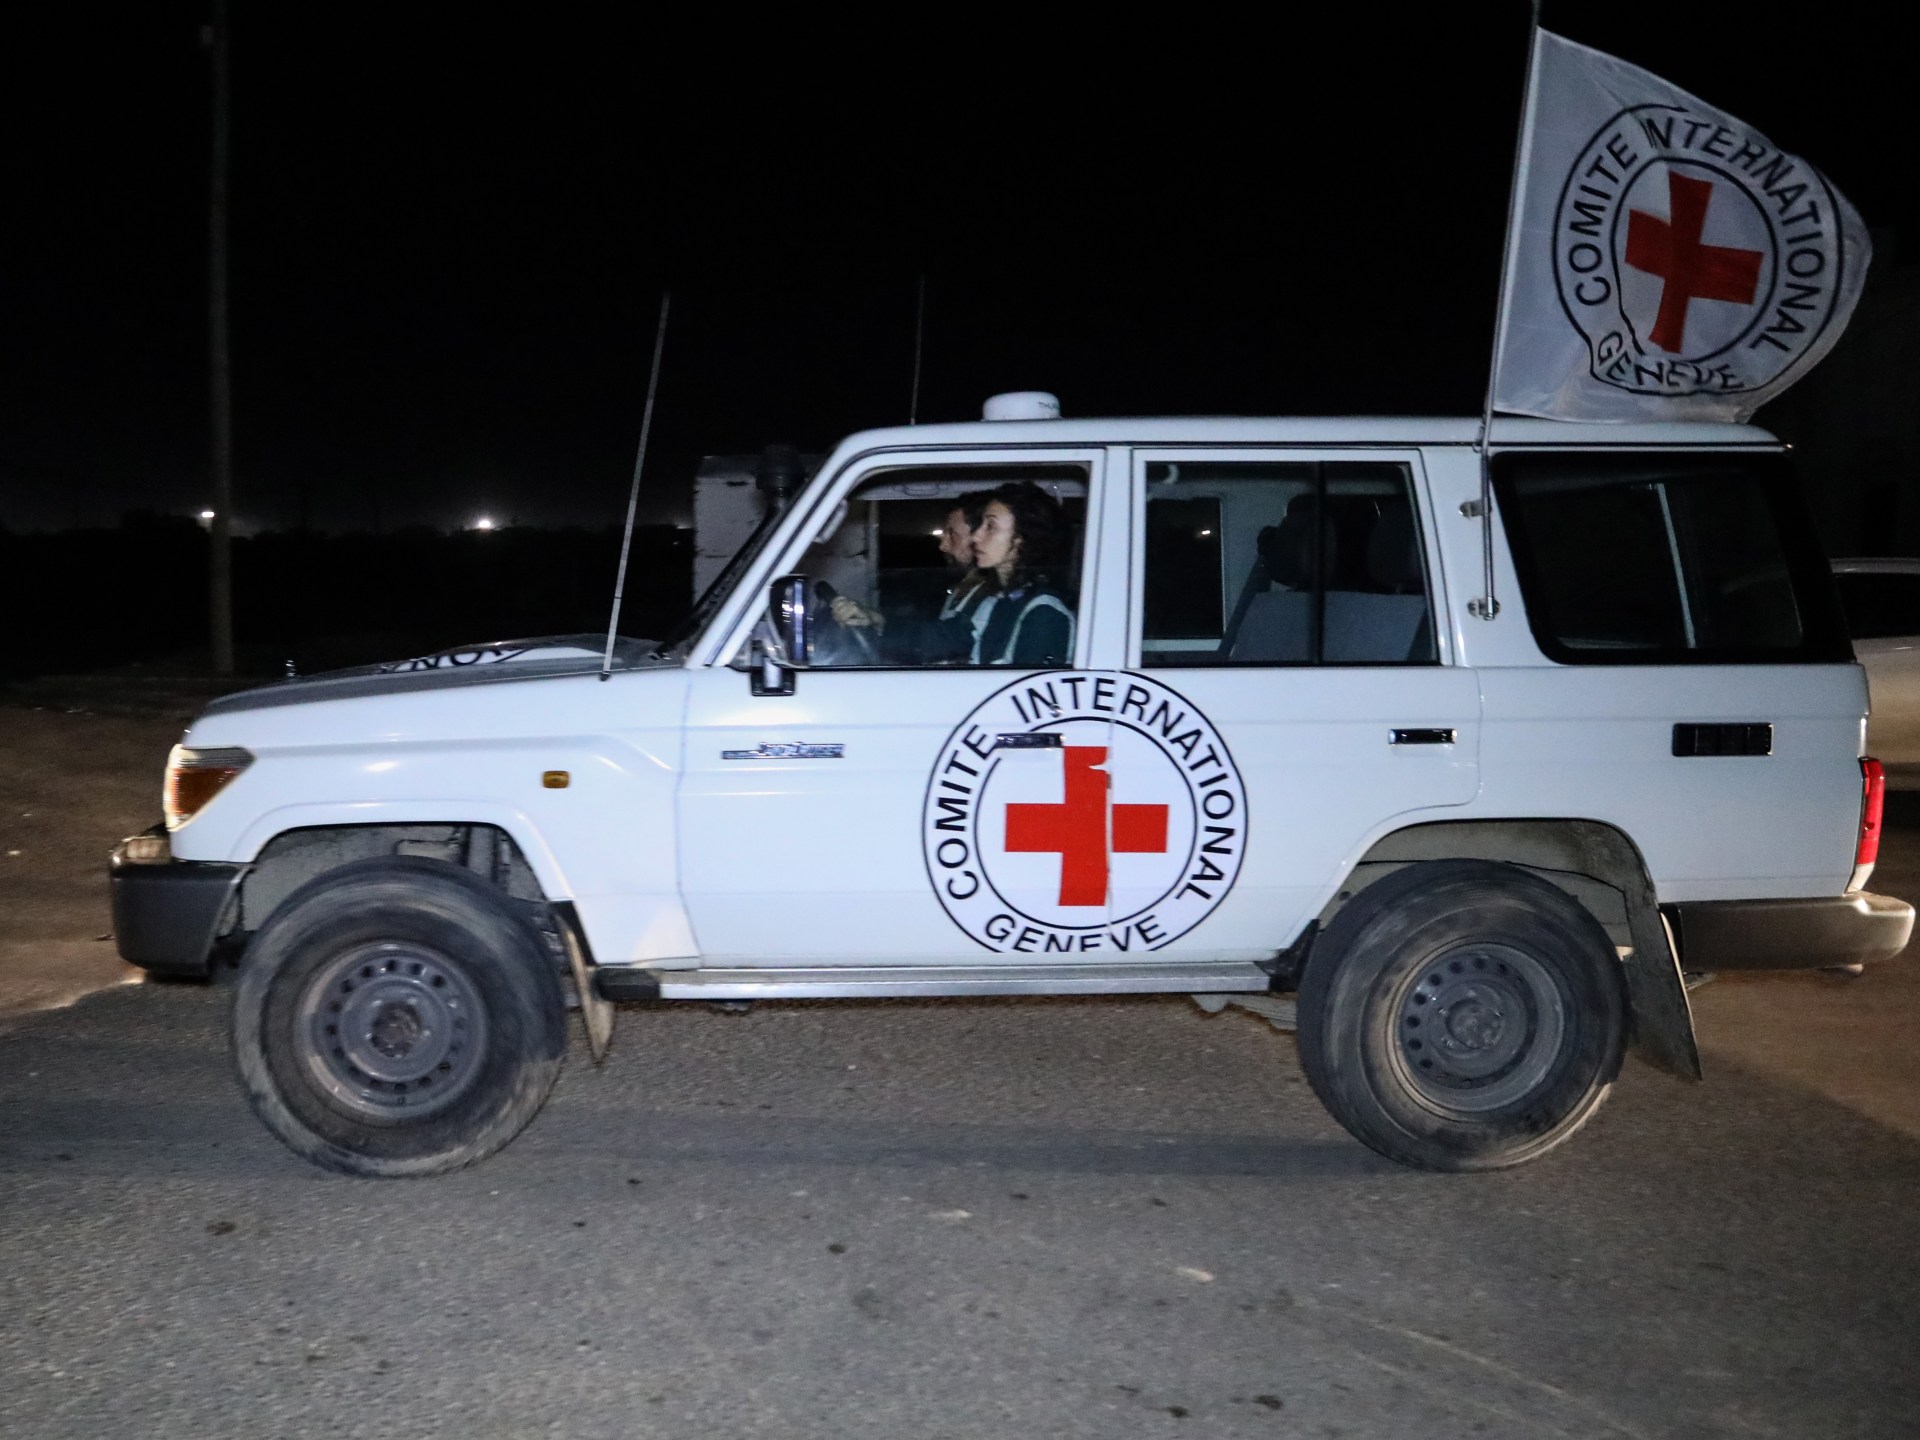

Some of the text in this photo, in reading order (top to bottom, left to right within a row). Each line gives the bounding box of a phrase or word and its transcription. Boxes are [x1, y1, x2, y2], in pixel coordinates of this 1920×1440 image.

[1568, 133, 1638, 306] COMITE
[1598, 330, 1745, 389] GENEVE
[935, 677, 1236, 901] COMITE INTERNATIONAL
[985, 914, 1168, 952] GENEVE
